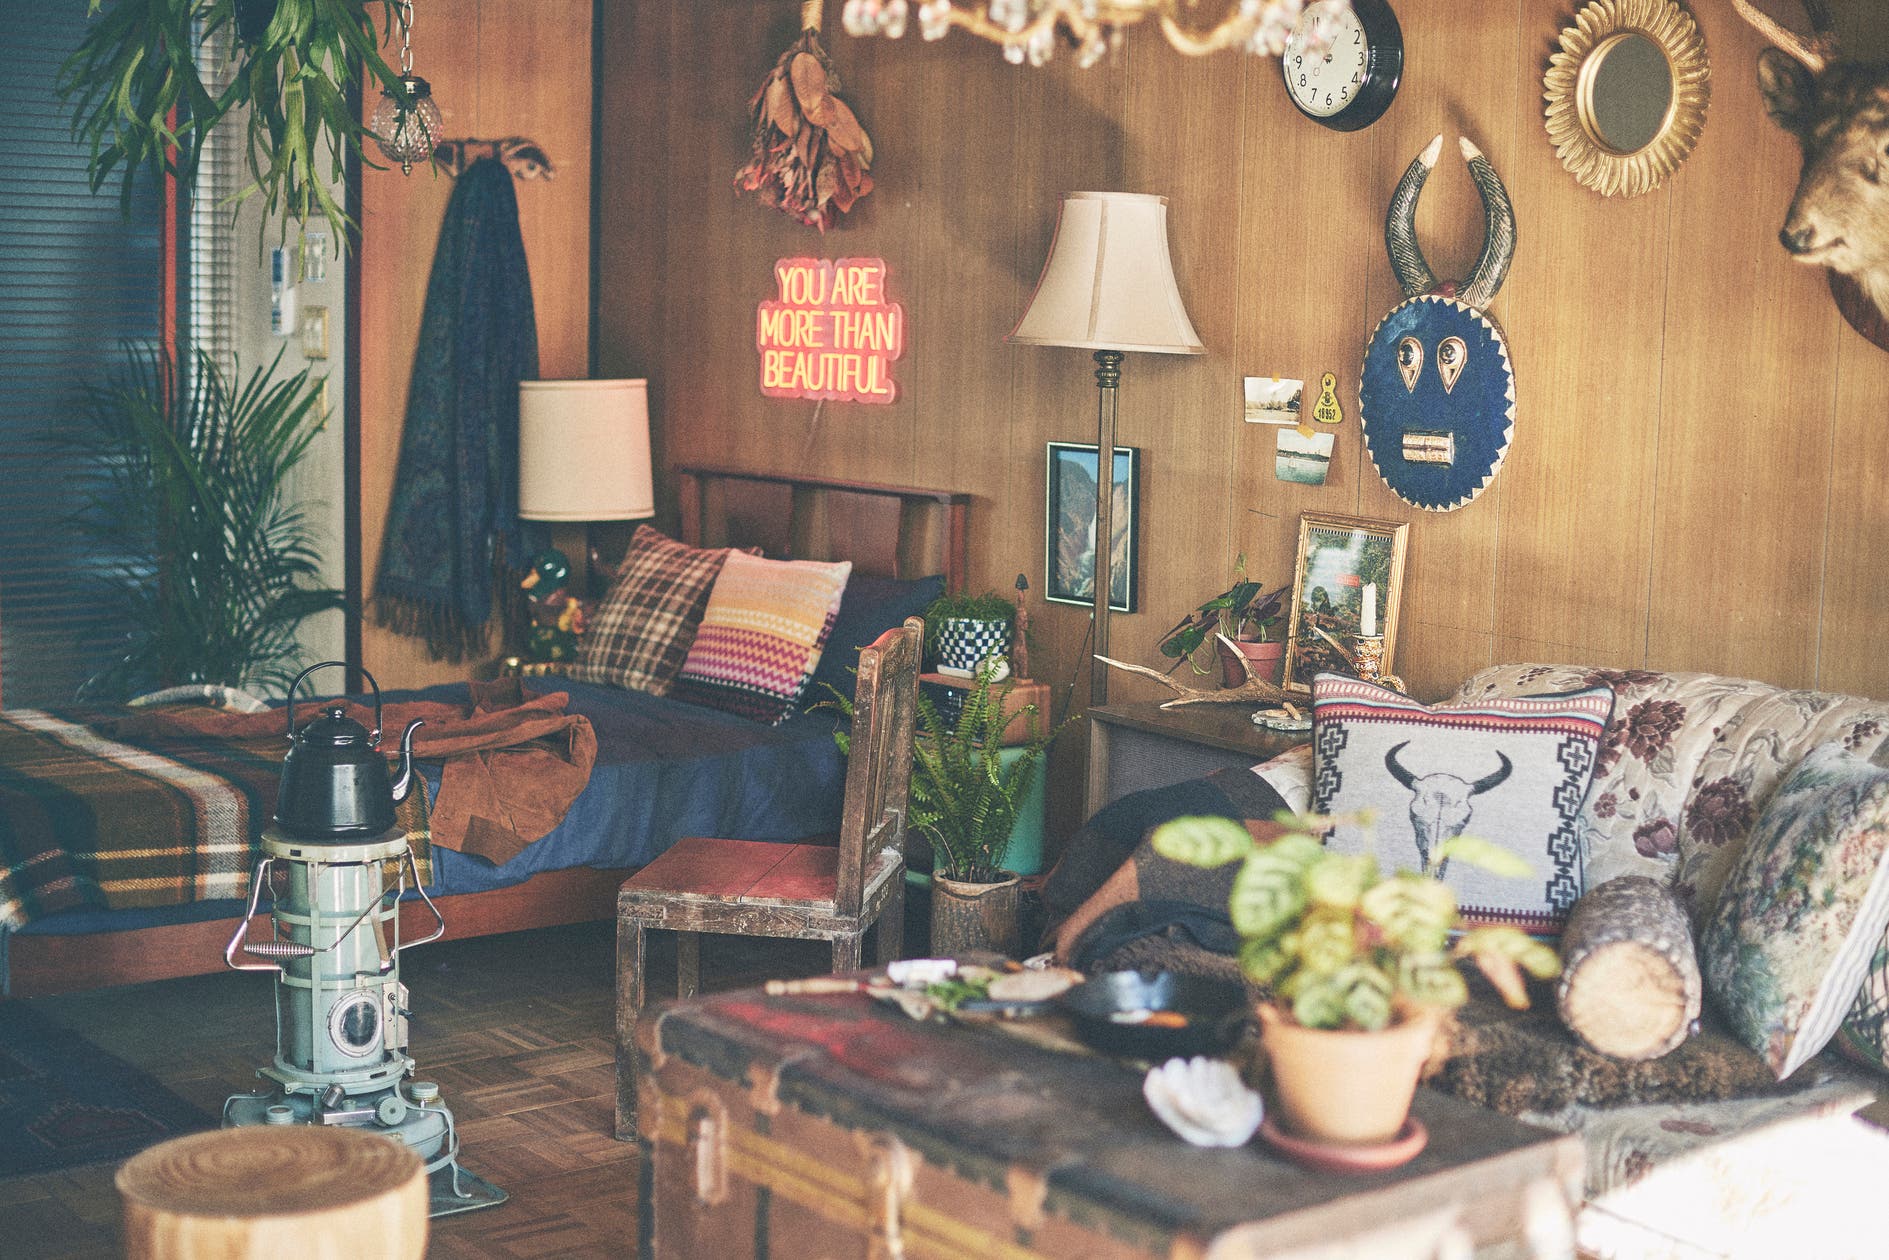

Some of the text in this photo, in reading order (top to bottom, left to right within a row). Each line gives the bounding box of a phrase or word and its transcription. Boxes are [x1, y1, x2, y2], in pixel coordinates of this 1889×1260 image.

[1353, 29, 1361, 44] 2
[1295, 55, 1302, 70] 9
[1357, 51, 1364, 66] 3
[1300, 73, 1307, 87] 8
[1351, 71, 1358, 84] 4
[1311, 88, 1318, 101] 7
[1325, 93, 1333, 106] 6
[1341, 86, 1348, 100] 5
[778, 267, 878, 305] YOU ARE
[760, 309, 895, 350] MORE THAN
[764, 350, 888, 393] BEAUTIFUL
